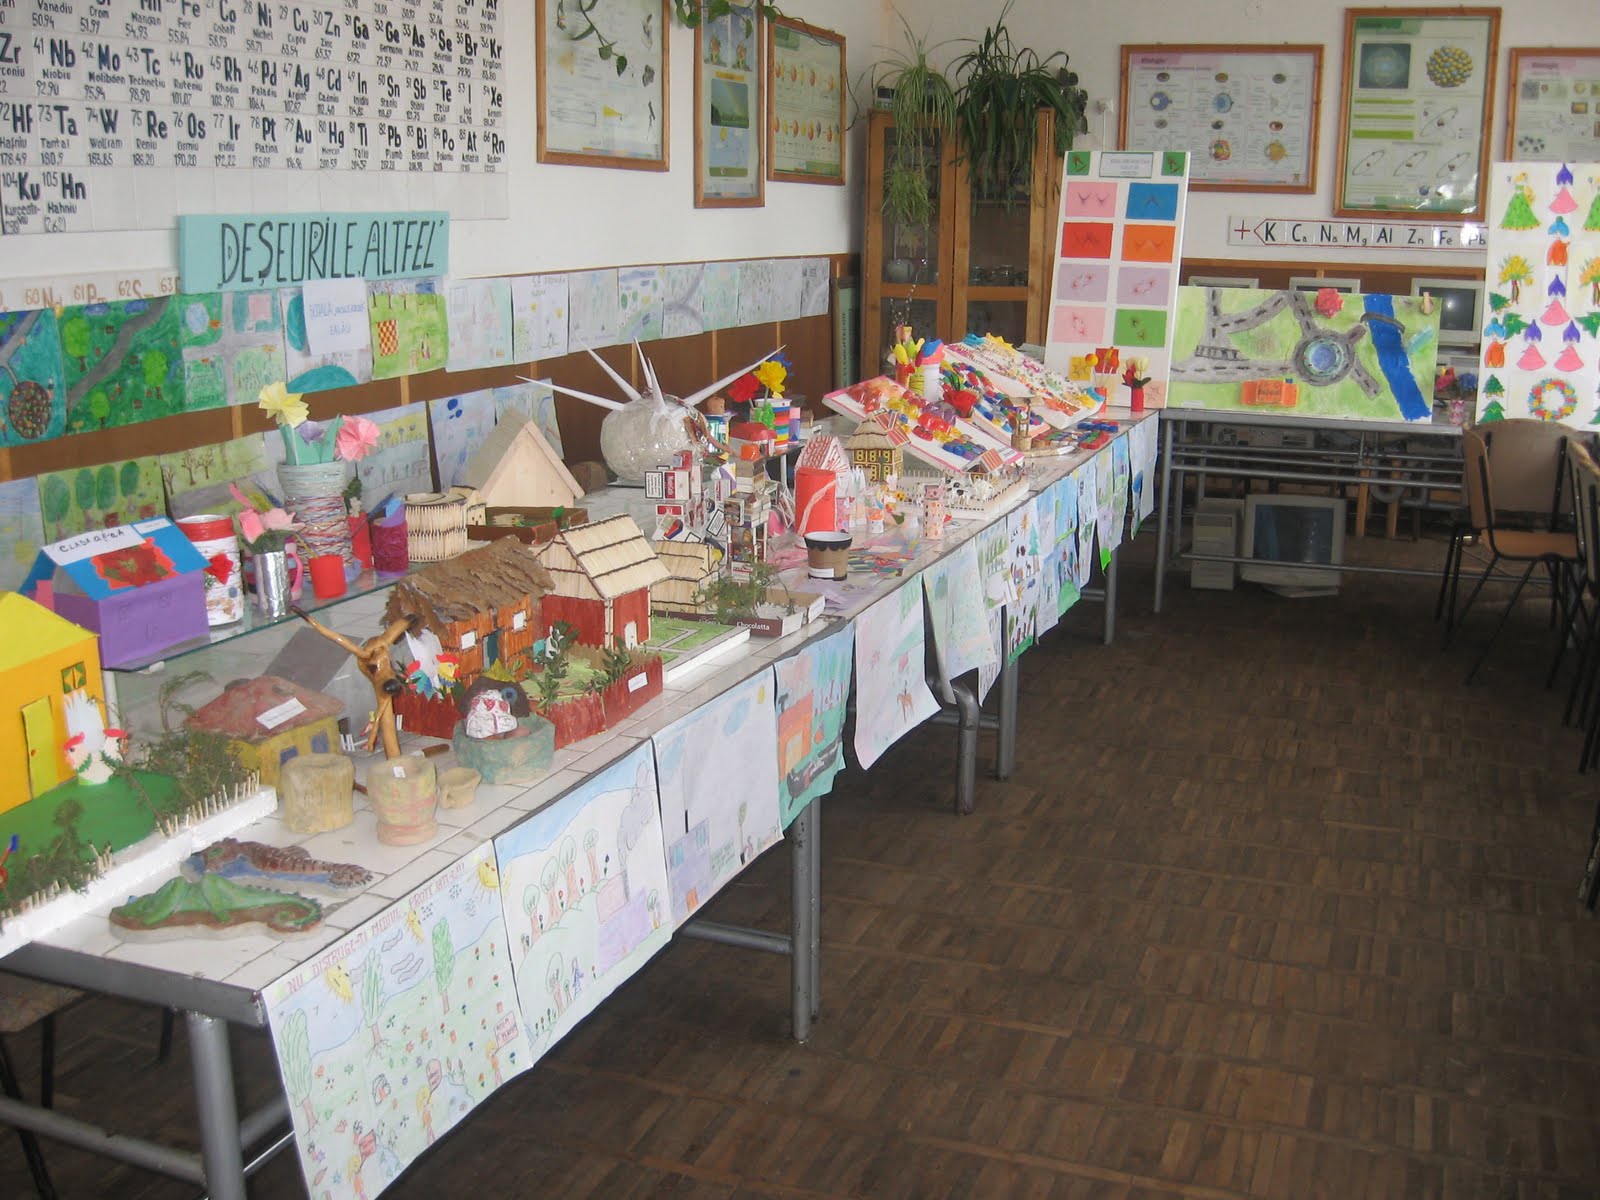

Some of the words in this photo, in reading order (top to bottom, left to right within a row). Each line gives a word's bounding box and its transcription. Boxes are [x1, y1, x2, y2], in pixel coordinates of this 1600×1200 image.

[220, 0, 236, 22] Co
[244, 1, 253, 14] 28
[258, 1, 272, 28] Ni
[280, 5, 288, 20] 29
[293, 8, 308, 33] Cu
[313, 10, 323, 25] 30
[325, 11, 340, 37] Zn
[354, 16, 369, 40] Ga
[375, 19, 383, 32] 32
[386, 21, 400, 43] Ge
[0, 33, 21, 63] Zr
[403, 24, 411, 37] 33
[412, 24, 425, 48] As
[430, 28, 437, 40] 34
[439, 29, 452, 52] Se
[457, 33, 464, 44] 35
[465, 33, 478, 56] Br
[481, 37, 489, 48] 36
[490, 38, 502, 59] Kr
[34, 37, 44, 54] 41
[50, 39, 75, 67] Nb
[82, 41, 94, 58] 42
[98, 44, 120, 72] Mo
[127, 47, 139, 63] 43
[141, 48, 160, 75] Tc
[43, 69, 71, 80] Niobiu
[170, 52, 180, 66] 44
[184, 52, 204, 79] Ru
[210, 56, 221, 71] 45
[224, 57, 242, 82] Rh
[248, 59, 258, 74] 46
[262, 60, 277, 86] Pd
[283, 63, 293, 77] 47
[295, 64, 310, 92] Ag
[316, 67, 325, 80] 48
[328, 69, 341, 92] Cd
[348, 71, 355, 82] 49
[358, 72, 367, 94] In
[378, 74, 385, 85] 50
[387, 75, 400, 97] Sn
[414, 78, 426, 100] Sb
[433, 80, 439, 90] 52
[441, 81, 451, 102] Te
[458, 83, 465, 93] 53
[483, 86, 490, 95] 54
[491, 86, 502, 107] Xe
[12, 104, 32, 133] Hf
[38, 105, 52, 122] 73
[54, 105, 78, 136] Ta
[86, 108, 98, 122] 74
[100, 108, 118, 134] W
[131, 110, 142, 127] 75
[147, 111, 168, 139] Re
[173, 112, 183, 128] 76
[188, 112, 206, 139] Os
[213, 114, 224, 128] 77
[229, 115, 240, 140] Ir
[250, 117, 260, 129] 78
[262, 117, 276, 142] Pt
[285, 118, 295, 132] 79
[296, 120, 312, 143] Au
[136, 138, 157, 150] Reniu
[319, 120, 326, 133] 80
[329, 122, 344, 148] Hg
[358, 123, 367, 146] Tl
[379, 123, 386, 135] 82
[388, 125, 401, 147] Pb
[407, 125, 414, 137] 83
[417, 128, 427, 149] Bi
[434, 127, 440, 139] 84
[443, 129, 454, 151] Po
[467, 131, 476, 152] At
[492, 133, 505, 154] Rn
[2, 172, 18, 188] 104
[18, 172, 40, 200] Ku
[42, 172, 58, 187] 105
[61, 172, 86, 199] Hn
[48, 202, 77, 214] Hahniu
[1265, 223, 1276, 241] K
[1292, 224, 1307, 242] Ca
[1320, 225, 1337, 243] Na
[1347, 227, 1367, 246] Mg
[1377, 228, 1392, 243] Al
[1408, 229, 1424, 244] Zn
[1439, 231, 1452, 245] Fe
[1468, 231, 1486, 245] Pb
[25, 288, 40, 305] 60
[74, 286, 85, 300] 61
[119, 280, 131, 297] 62
[59, 538, 91, 552] CLASA
[736, 621, 770, 631] Chocolatta
[287, 976, 304, 994] NU
